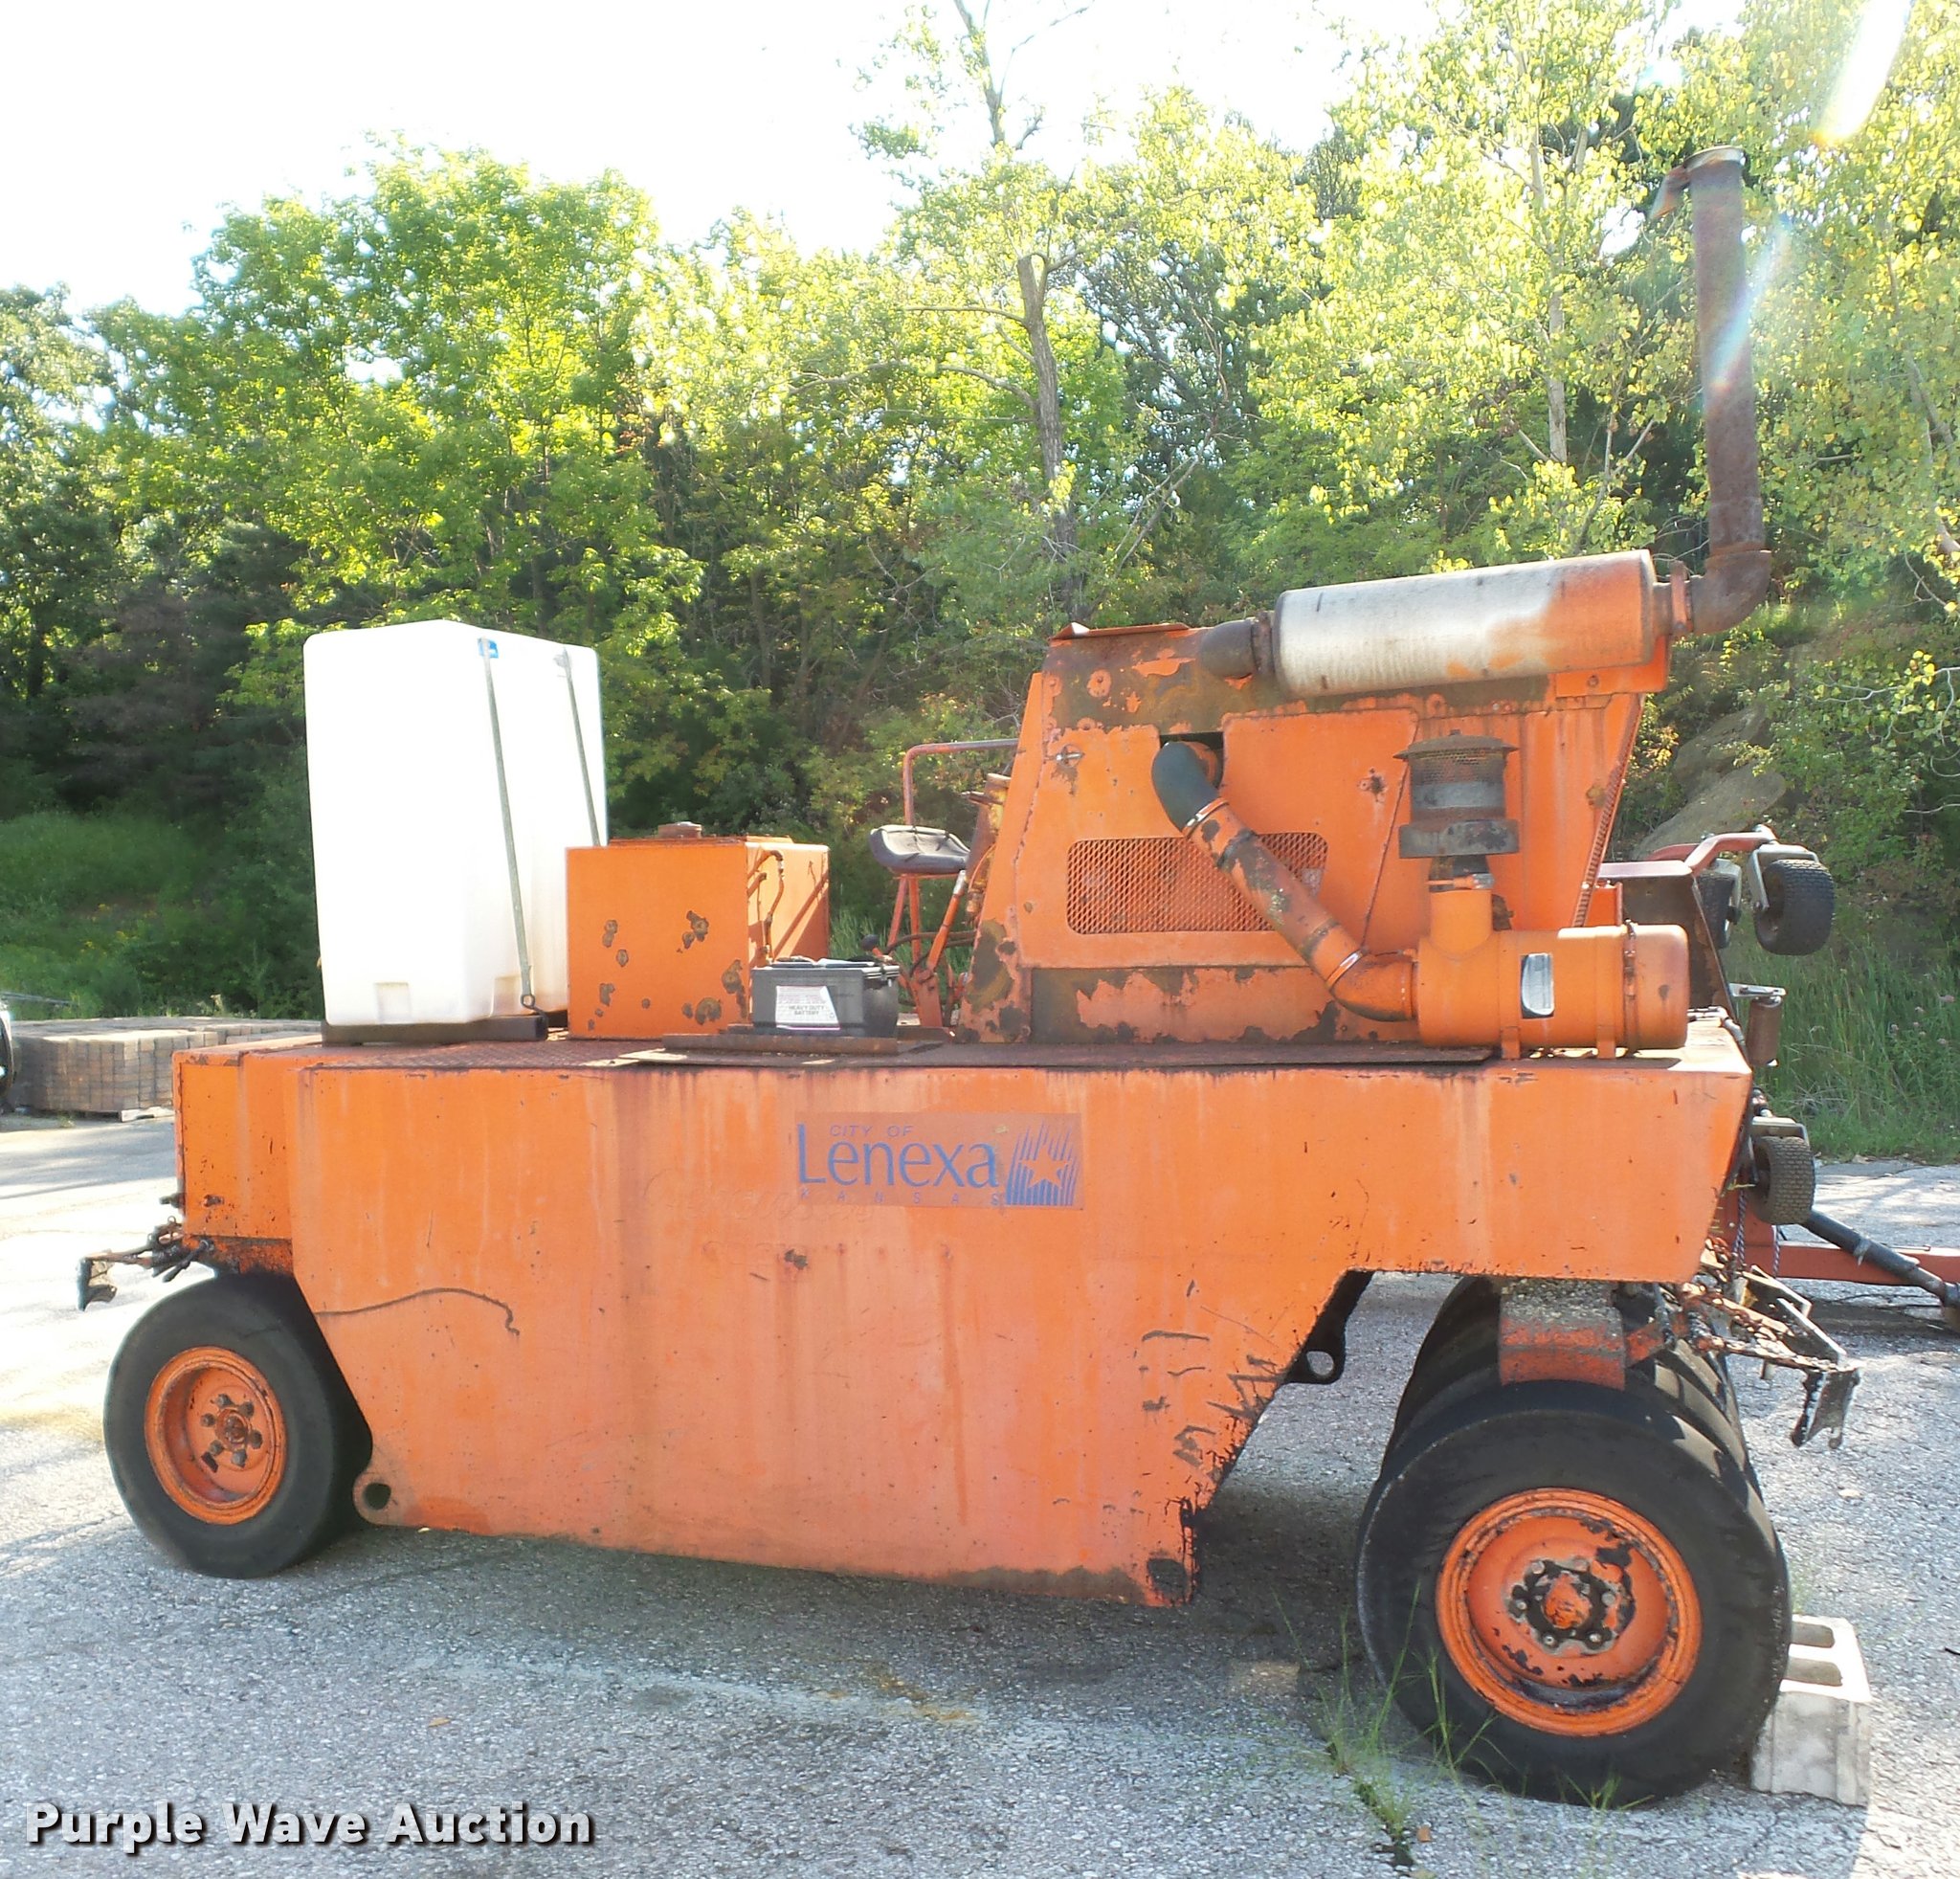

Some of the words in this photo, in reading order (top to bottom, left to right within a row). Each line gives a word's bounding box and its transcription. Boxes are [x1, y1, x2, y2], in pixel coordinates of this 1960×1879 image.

[830, 1125, 873, 1137] CITY
[887, 1125, 914, 1137] OF
[797, 1123, 998, 1188] Lenexa
